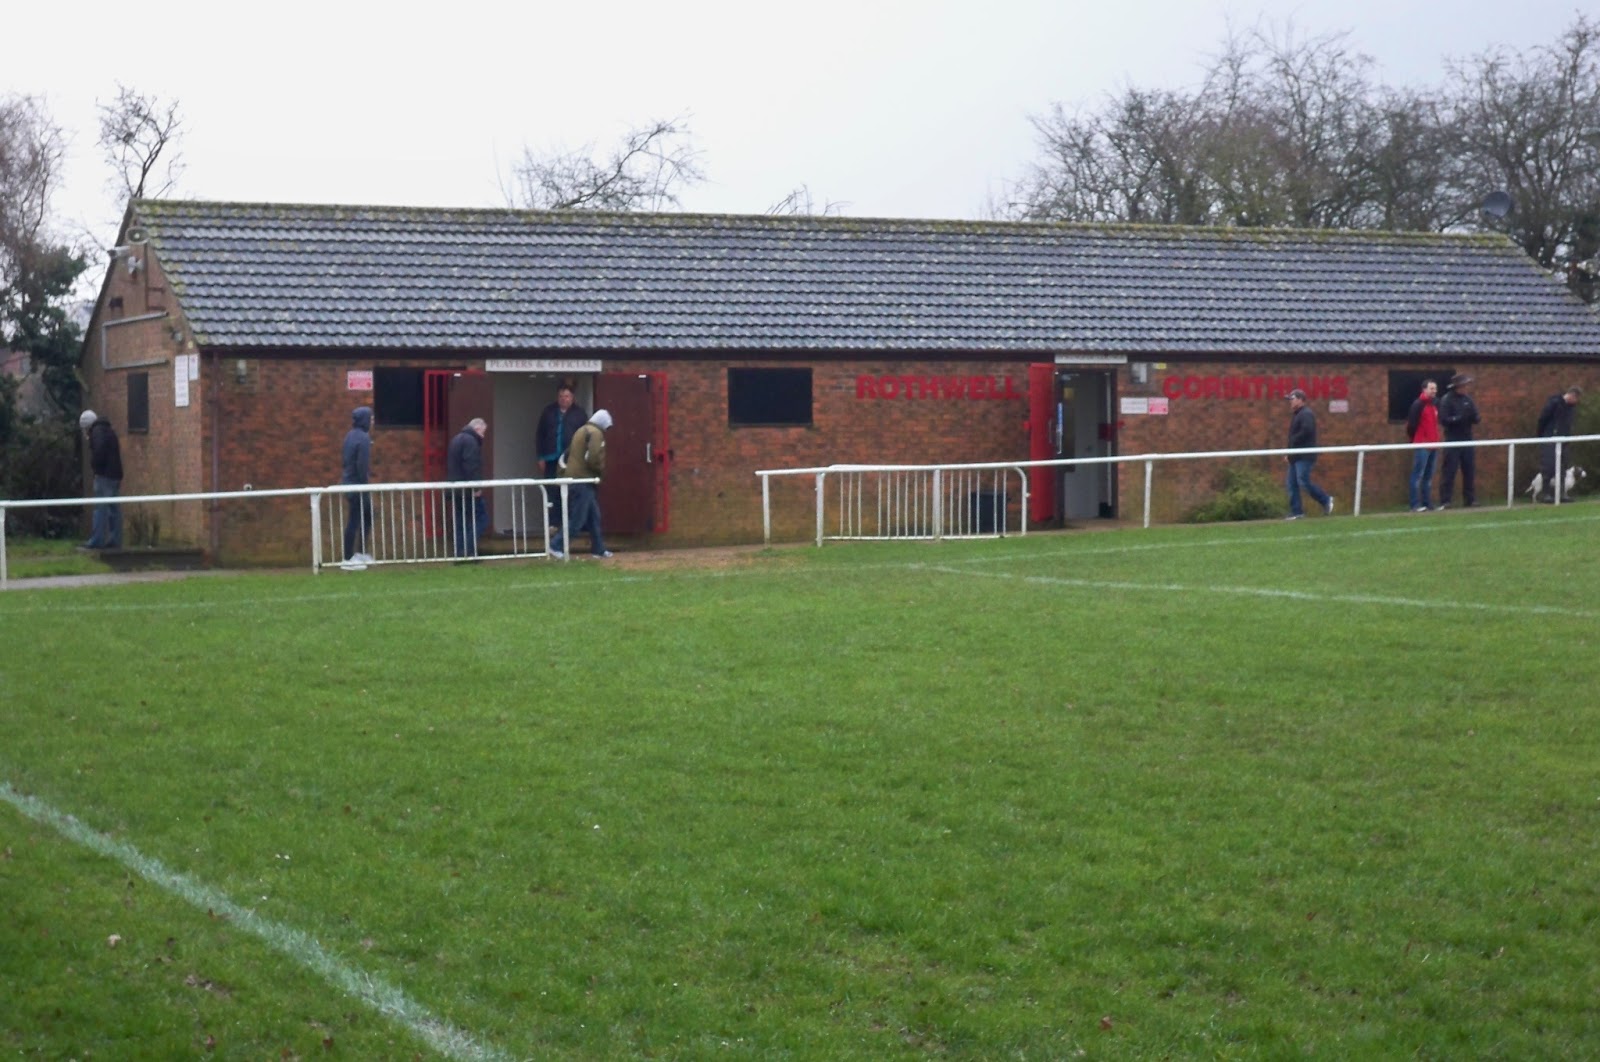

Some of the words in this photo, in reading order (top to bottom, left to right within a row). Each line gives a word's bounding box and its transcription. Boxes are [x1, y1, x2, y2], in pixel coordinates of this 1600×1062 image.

[490, 360, 532, 369] PLAYERS
[536, 360, 544, 369] &
[548, 360, 598, 369] OFFICIALS
[856, 374, 1021, 400] ROTHWELL
[1163, 375, 1349, 400] CORINTHIANS
